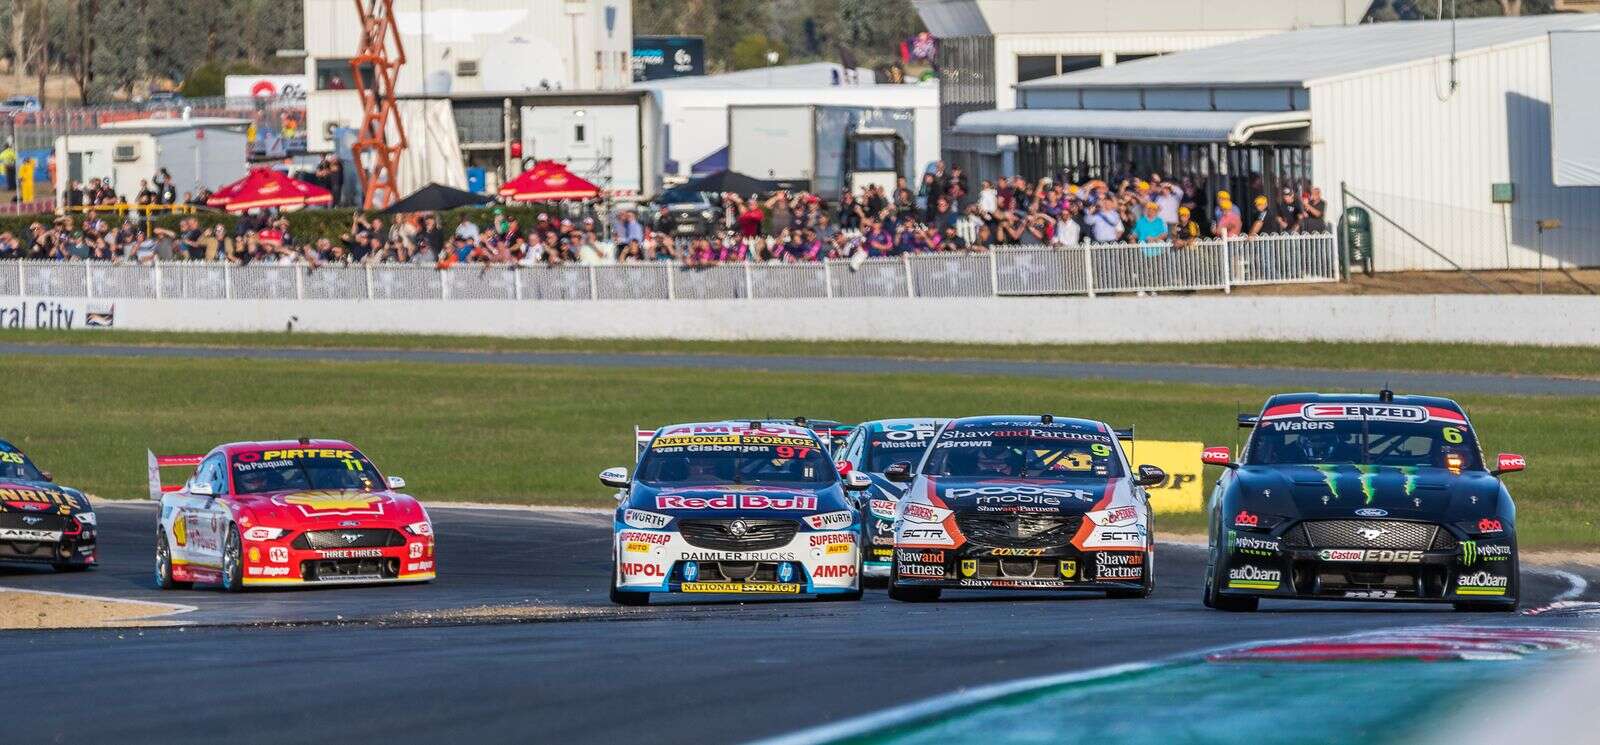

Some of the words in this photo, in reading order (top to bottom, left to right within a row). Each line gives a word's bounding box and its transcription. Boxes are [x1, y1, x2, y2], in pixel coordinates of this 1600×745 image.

[36, 302, 74, 328] City
[1345, 406, 1417, 417] ENZED
[1273, 420, 1335, 431] Waters
[942, 428, 1111, 443] ShawandPartners
[1442, 426, 1464, 444] 6
[657, 436, 735, 446] NATIONAL
[743, 437, 815, 447] STORAGE
[881, 440, 927, 449] Mostert
[943, 440, 993, 449] Brown
[263, 449, 354, 461] PIRTEK
[687, 445, 770, 453] Gisbergen
[776, 446, 812, 459] 97
[1090, 443, 1113, 457] 9
[341, 459, 364, 472] 11
[656, 494, 737, 510] Red
[740, 494, 818, 511] Bull
[976, 494, 1061, 506] mobile
[632, 511, 666, 527] WÜRTH
[823, 513, 852, 525] WÜRTH
[902, 529, 944, 538] SCTR
[1100, 531, 1140, 541] SCTR
[827, 545, 849, 553] AUTO
[1235, 536, 1280, 552] MONSTER
[1477, 543, 1512, 556] MONSTER
[350, 550, 383, 558] THREES
[681, 552, 742, 561] DAIMLER
[744, 552, 796, 561] TRUCKS
[896, 549, 945, 563] Shawand
[1331, 550, 1363, 561] Castrol
[1363, 550, 1425, 563] EDGE
[896, 563, 945, 577] Partners
[684, 583, 739, 592] NATIONAL
[743, 583, 798, 593] STORAGE
